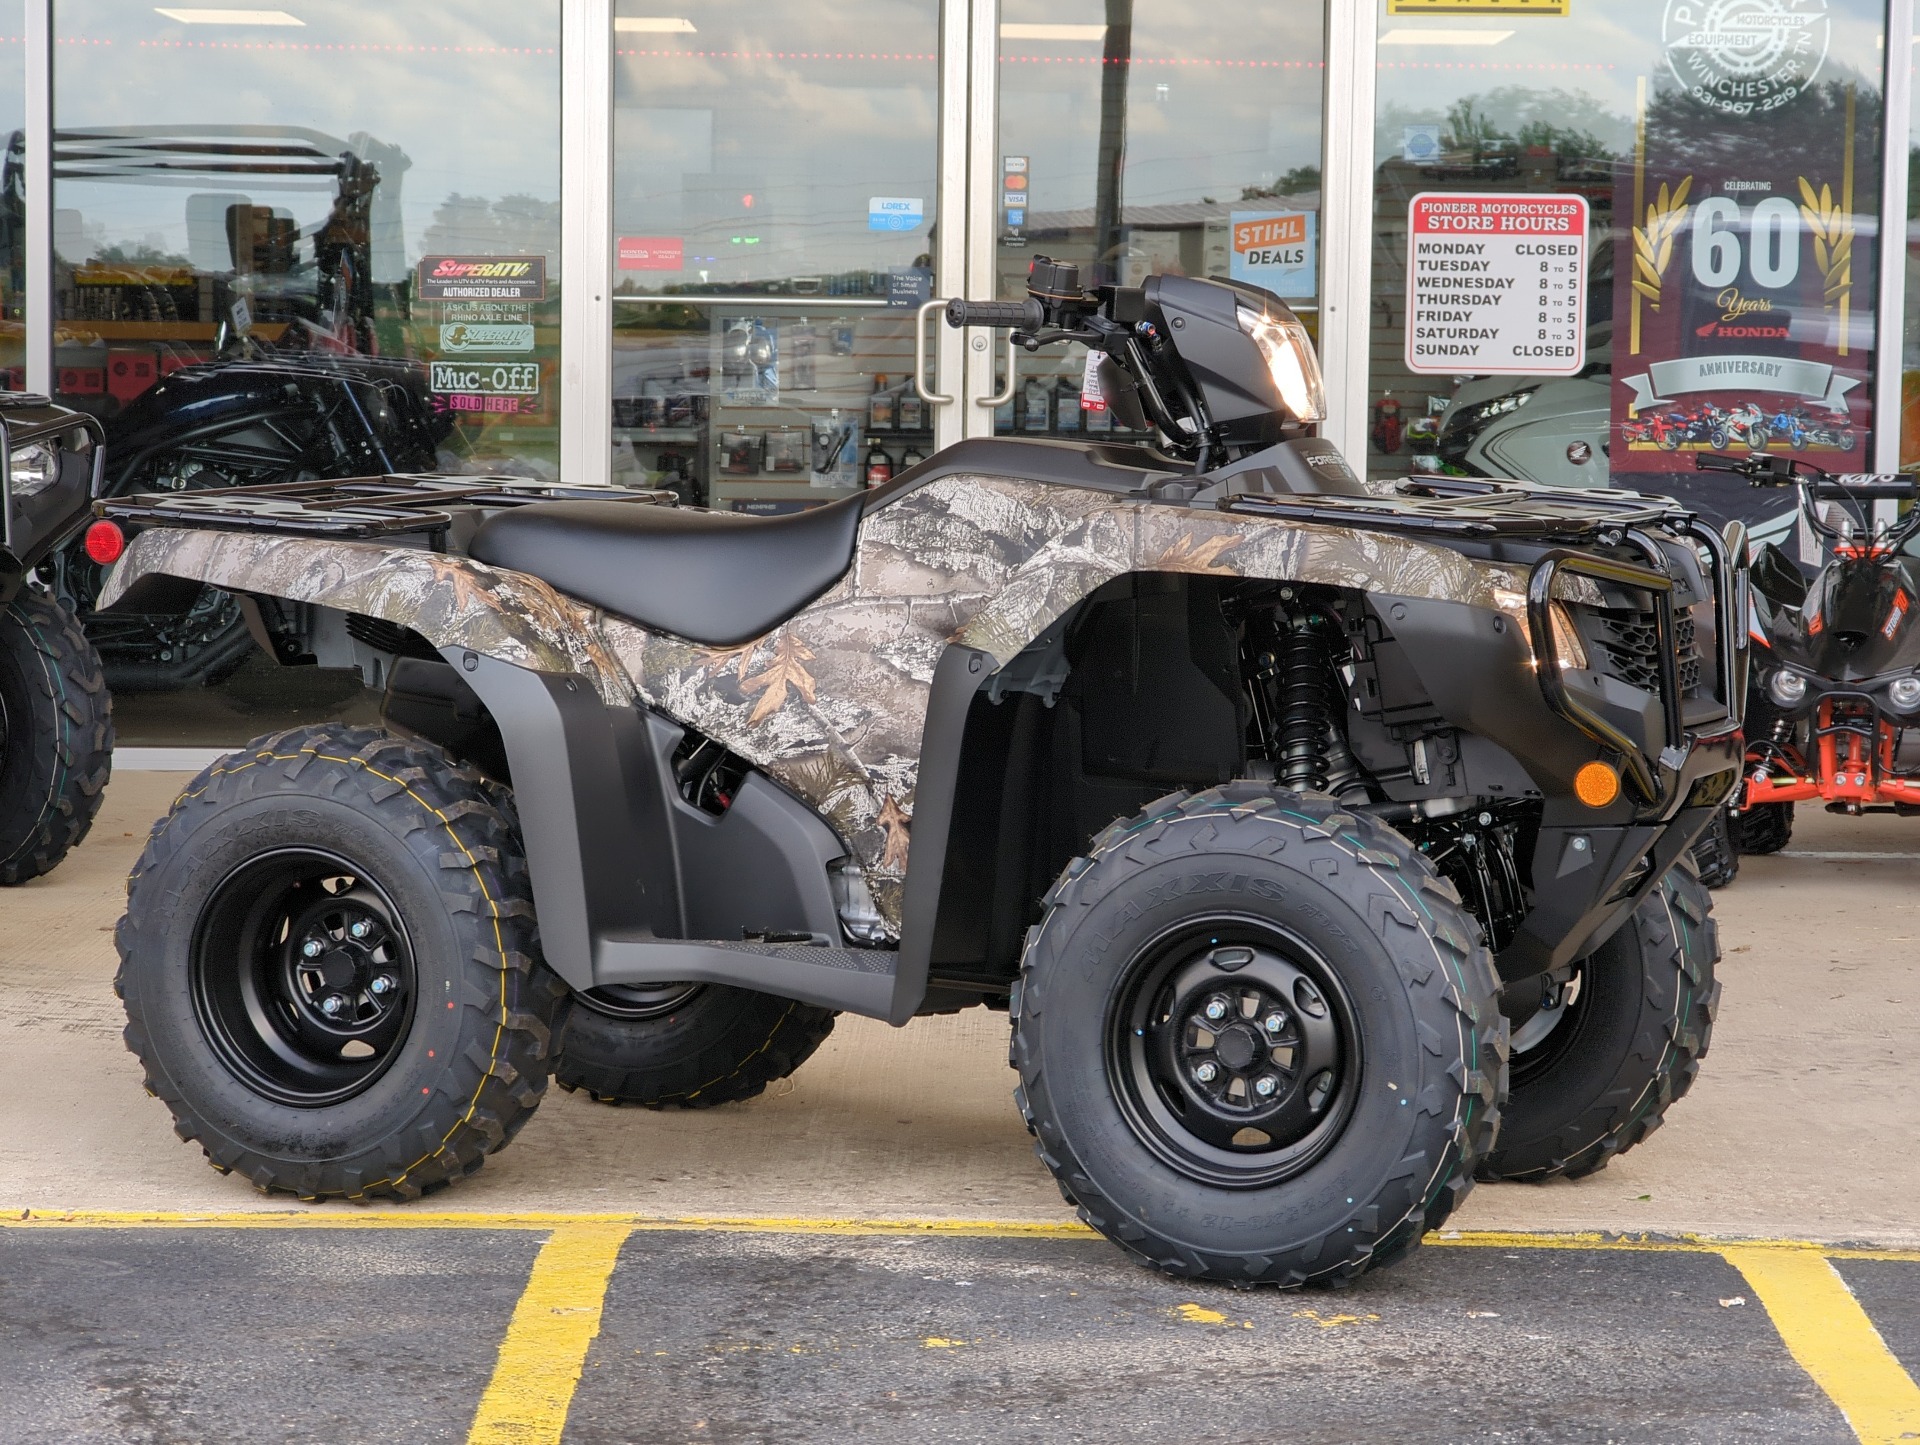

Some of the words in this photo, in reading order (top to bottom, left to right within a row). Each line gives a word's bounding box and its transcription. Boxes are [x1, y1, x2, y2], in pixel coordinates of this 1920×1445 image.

[1737, 15, 1805, 26] MOTORCYCLES
[1688, 34, 1757, 46] EQUIPMENT
[1793, 31, 1813, 56] TN
[1692, 86, 1797, 114] 931-967-2219
[1724, 181, 1772, 191] CELEBRATING
[881, 202, 911, 211] LOREX
[1421, 202, 1477, 213] PIONEER
[1481, 204, 1577, 215] MOTORCYCLES
[1428, 216, 1494, 230] STORE
[1500, 217, 1570, 231] HOURS
[1238, 221, 1300, 245] STIHL
[1692, 196, 1800, 288] 60
[1418, 243, 1486, 254] MONDAY
[1515, 244, 1578, 256] CLOSED
[1248, 249, 1304, 265] DEALS
[1418, 260, 1491, 271] TUESDAY
[1540, 261, 1548, 272] 8
[1569, 262, 1577, 273] 5
[1417, 277, 1515, 288] WEDNESDAY
[1539, 278, 1548, 289] 8
[1568, 278, 1577, 290] 5
[443, 287, 490, 297] AUTHORIZED
[491, 287, 521, 298] DEALER
[1417, 294, 1502, 305] THURSDAY
[1538, 295, 1547, 306] 8
[1567, 296, 1576, 307] 5
[1717, 287, 1774, 321] Years
[480, 304, 508, 312] ABOUT
[510, 304, 527, 312] THE
[451, 313, 478, 321] RHINO
[1417, 311, 1473, 322] FRIDAY
[1538, 312, 1547, 323] 8
[1567, 312, 1576, 323] 5
[1416, 328, 1500, 339] SATURDAY
[1538, 329, 1546, 340] 8
[1567, 329, 1575, 340] 3
[1717, 327, 1791, 338] HONDA
[1416, 344, 1480, 356] SUNDAY
[1512, 345, 1575, 357] CLOSED
[1699, 361, 1783, 377] ANNIVERSARY
[435, 367, 534, 390] Muc-Off
[451, 396, 481, 410] SOLD
[486, 398, 518, 412] HERE
[1838, 474, 1896, 486] KAYO
[1079, 871, 1289, 974] MAXXIS
